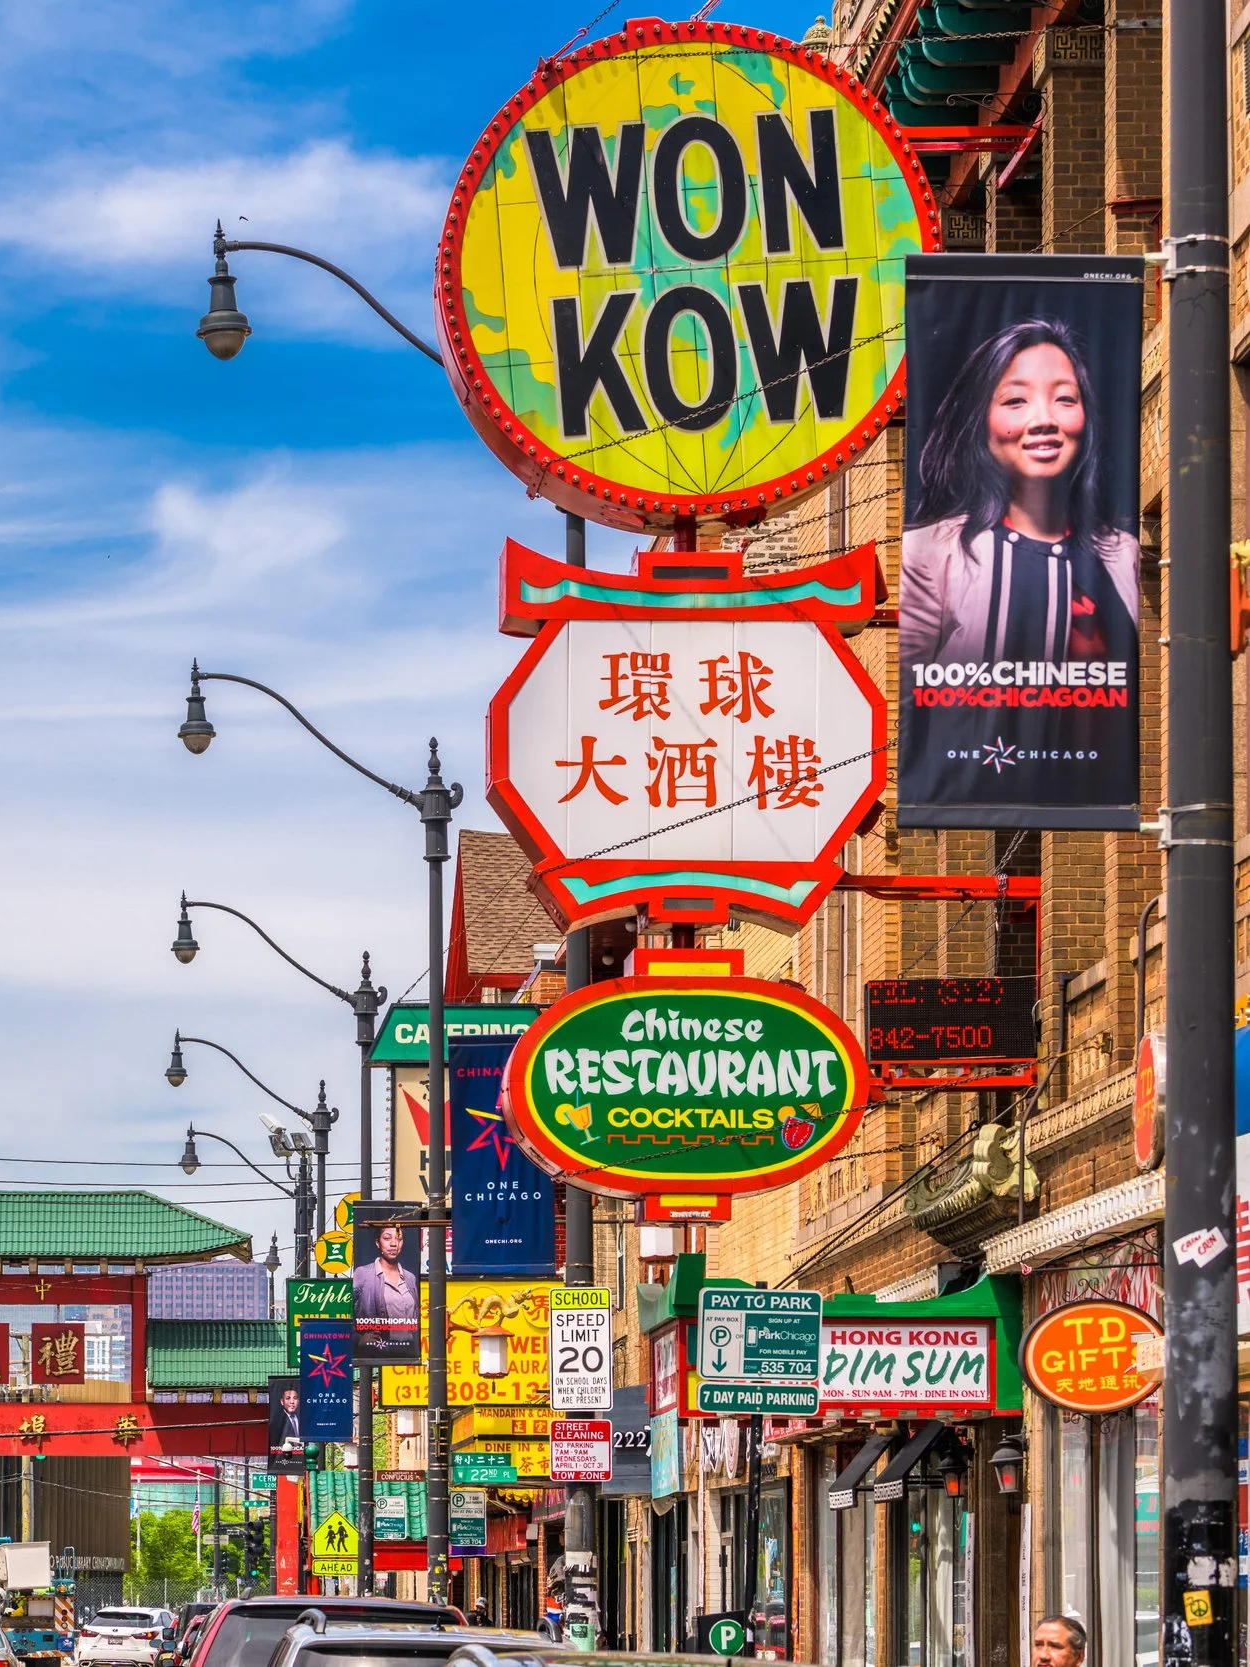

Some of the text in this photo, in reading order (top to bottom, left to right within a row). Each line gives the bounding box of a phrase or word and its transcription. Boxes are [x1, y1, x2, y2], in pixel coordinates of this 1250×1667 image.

[522, 108, 847, 268] WON
[1083, 272, 1132, 280] ONECHI.ORG
[548, 274, 860, 441] KOW
[911, 660, 1128, 687] 100%CHINESE
[598, 651, 776, 723] 環球
[912, 687, 1129, 708] 100%CHICAGOAN
[947, 750, 1099, 761] ONE CHICAGO
[554, 735, 825, 811] 大酒樓
[620, 1007, 764, 1043] Chinese
[869, 1025, 993, 1050] 842-7500
[544, 1048, 838, 1099] RESTAURANT
[607, 1106, 776, 1131] COCKTAILS
[486, 1181, 519, 1190] ONE
[464, 1191, 542, 1202] CHICAGO
[293, 1282, 353, 1312] Triple
[555, 1292, 607, 1306] SCHOOL
[711, 1295, 812, 1310] PAY TO PARK
[556, 1314, 605, 1327] SPEED
[561, 1329, 599, 1342] LIMIT
[758, 1330, 816, 1343] ParkChicago
[1063, 1316, 1126, 1345] TD
[830, 1330, 978, 1346] HONG KONG
[559, 1346, 604, 1374] 20
[761, 1362, 784, 1373] 535
[788, 1363, 812, 1374] 704
[823, 1347, 985, 1387] DIM SUM
[555, 1377, 608, 1386] ON SCHOOL DAYS
[557, 1387, 606, 1396] WHEN CHILDREN
[823, 1390, 986, 1399] MON SUN 9AM 7PM DINE IN ONLY
[561, 1396, 602, 1405] ARE PRESENT
[703, 1391, 815, 1406] 7 DAY PAID PARKING
[480, 1408, 528, 1419] MANDARIN
[528, 1408, 534, 1418] &
[554, 1422, 590, 1431] STREET
[554, 1431, 604, 1440] CLEANING
[485, 1443, 545, 1452] DINE IN &
[470, 1469, 498, 1481] 22ND
[554, 1472, 606, 1480] TOW ZONE
[321, 1563, 353, 1572] AHEAD
[720, 1626, 736, 1650] P
